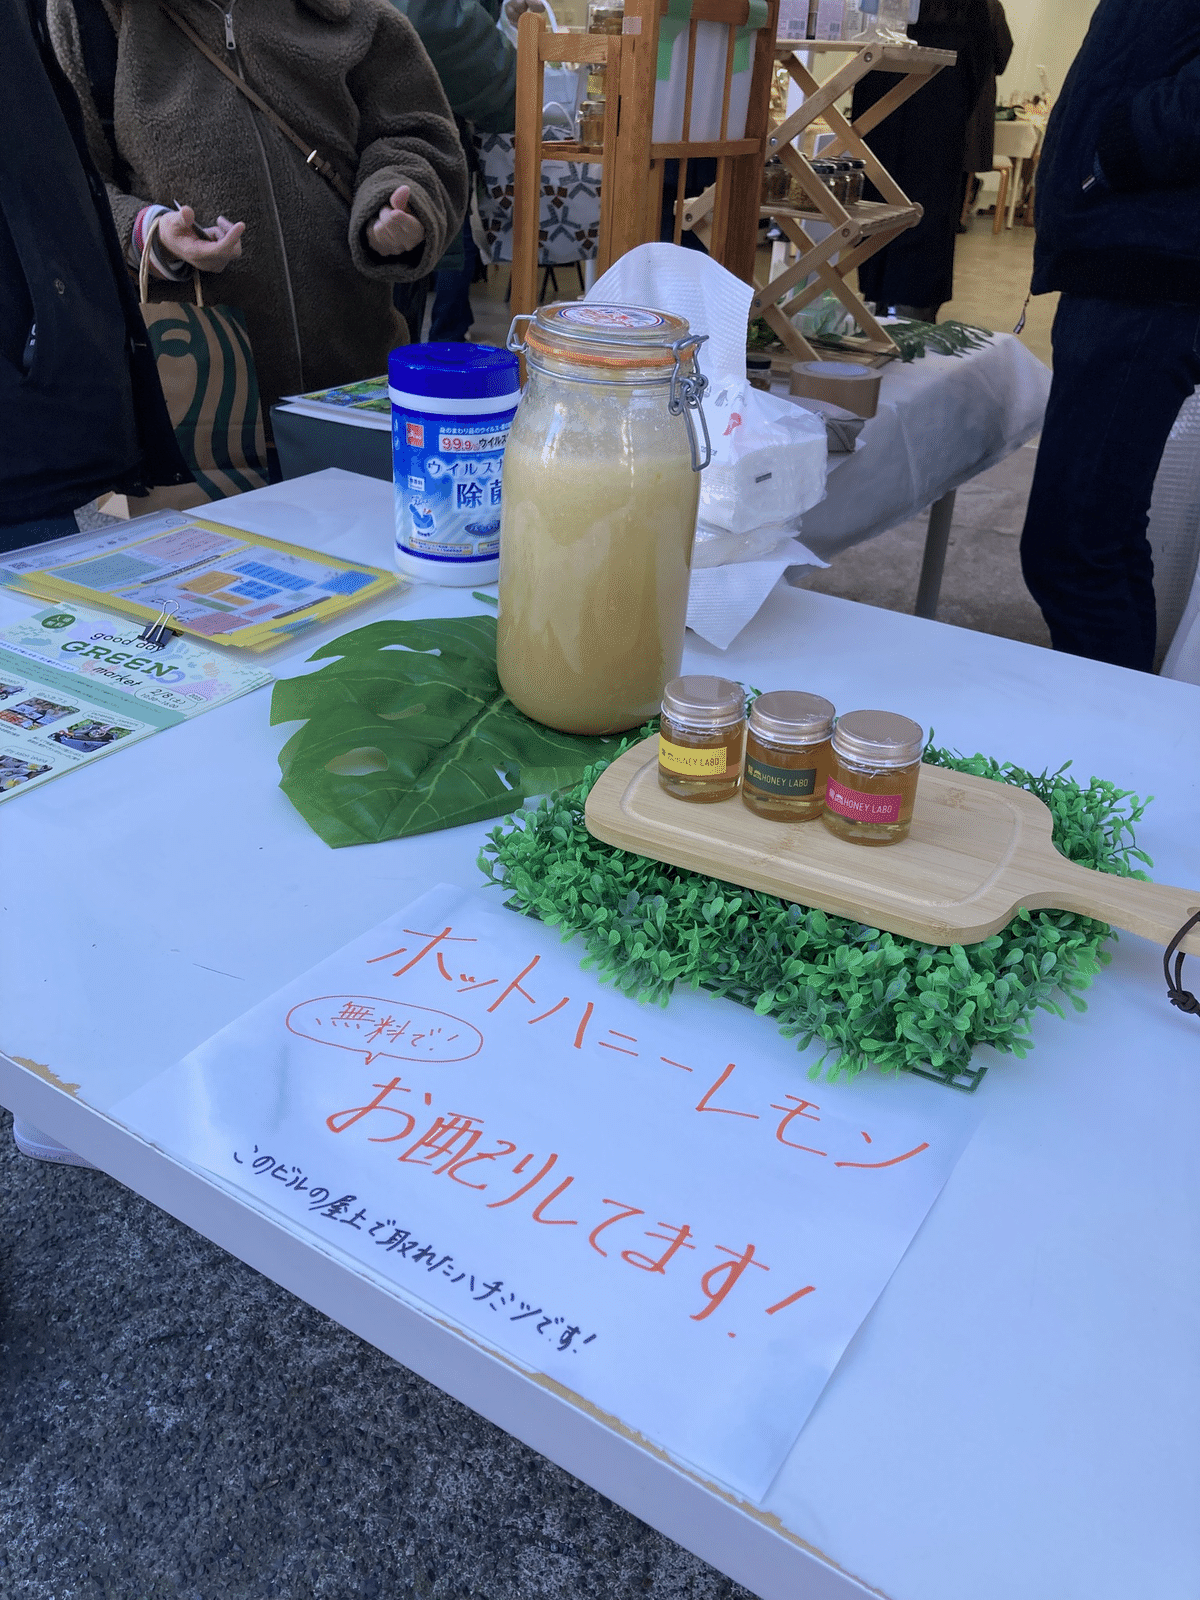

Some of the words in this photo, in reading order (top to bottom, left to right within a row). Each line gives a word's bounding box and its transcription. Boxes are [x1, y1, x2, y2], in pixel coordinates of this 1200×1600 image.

[90, 632, 139, 646] good
[136, 639, 166, 654] day
[61, 640, 181, 677] GREEN
[92, 665, 144, 687] market
[761, 773, 787, 787] HONEY
[788, 778, 809, 788] LABO
[843, 797, 870, 812] HONEY
[871, 804, 893, 814] LABO
[366, 927, 930, 1169] ホットハニーレモン
